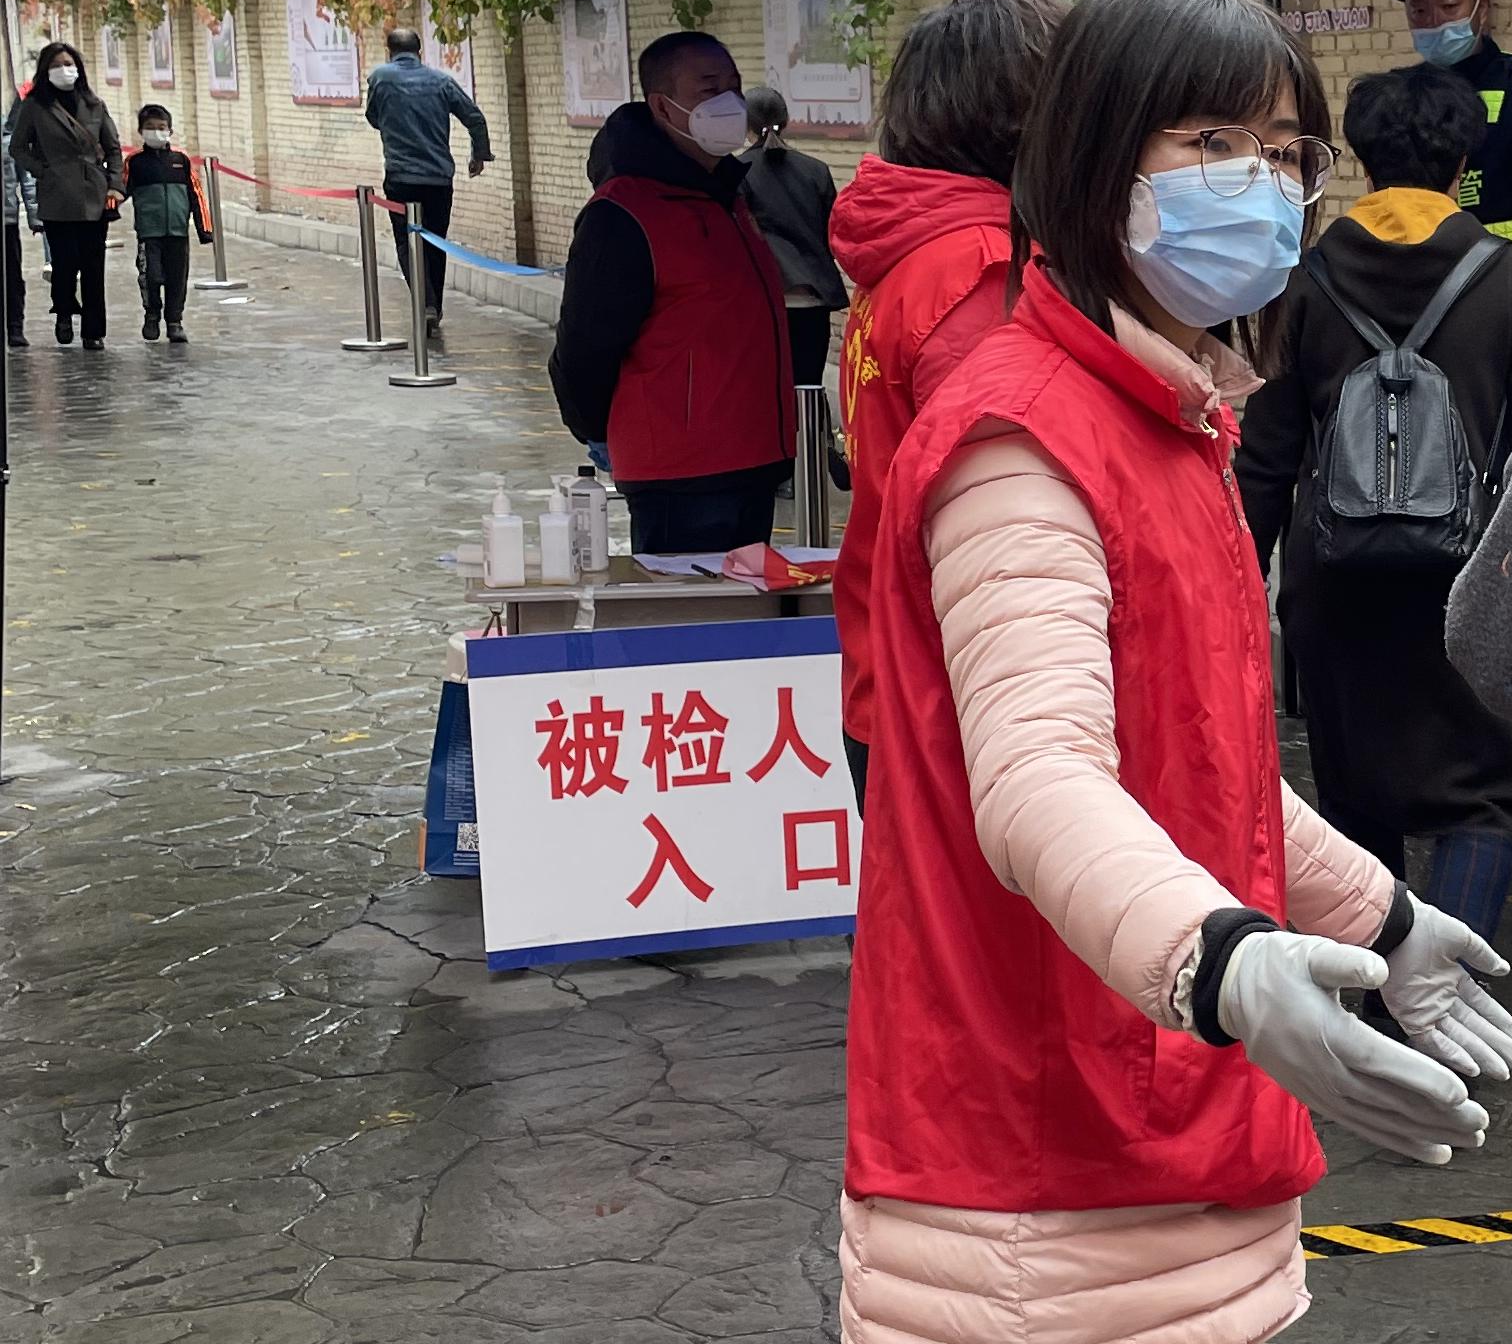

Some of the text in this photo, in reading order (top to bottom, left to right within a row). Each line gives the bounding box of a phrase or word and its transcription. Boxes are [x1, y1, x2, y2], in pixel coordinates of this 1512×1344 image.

[1304, 8, 1330, 33] JIA
[1331, 6, 1369, 30] YUAN
[1457, 169, 1483, 207] 管
[535, 687, 832, 800] 被检人
[626, 808, 852, 909] 入口
